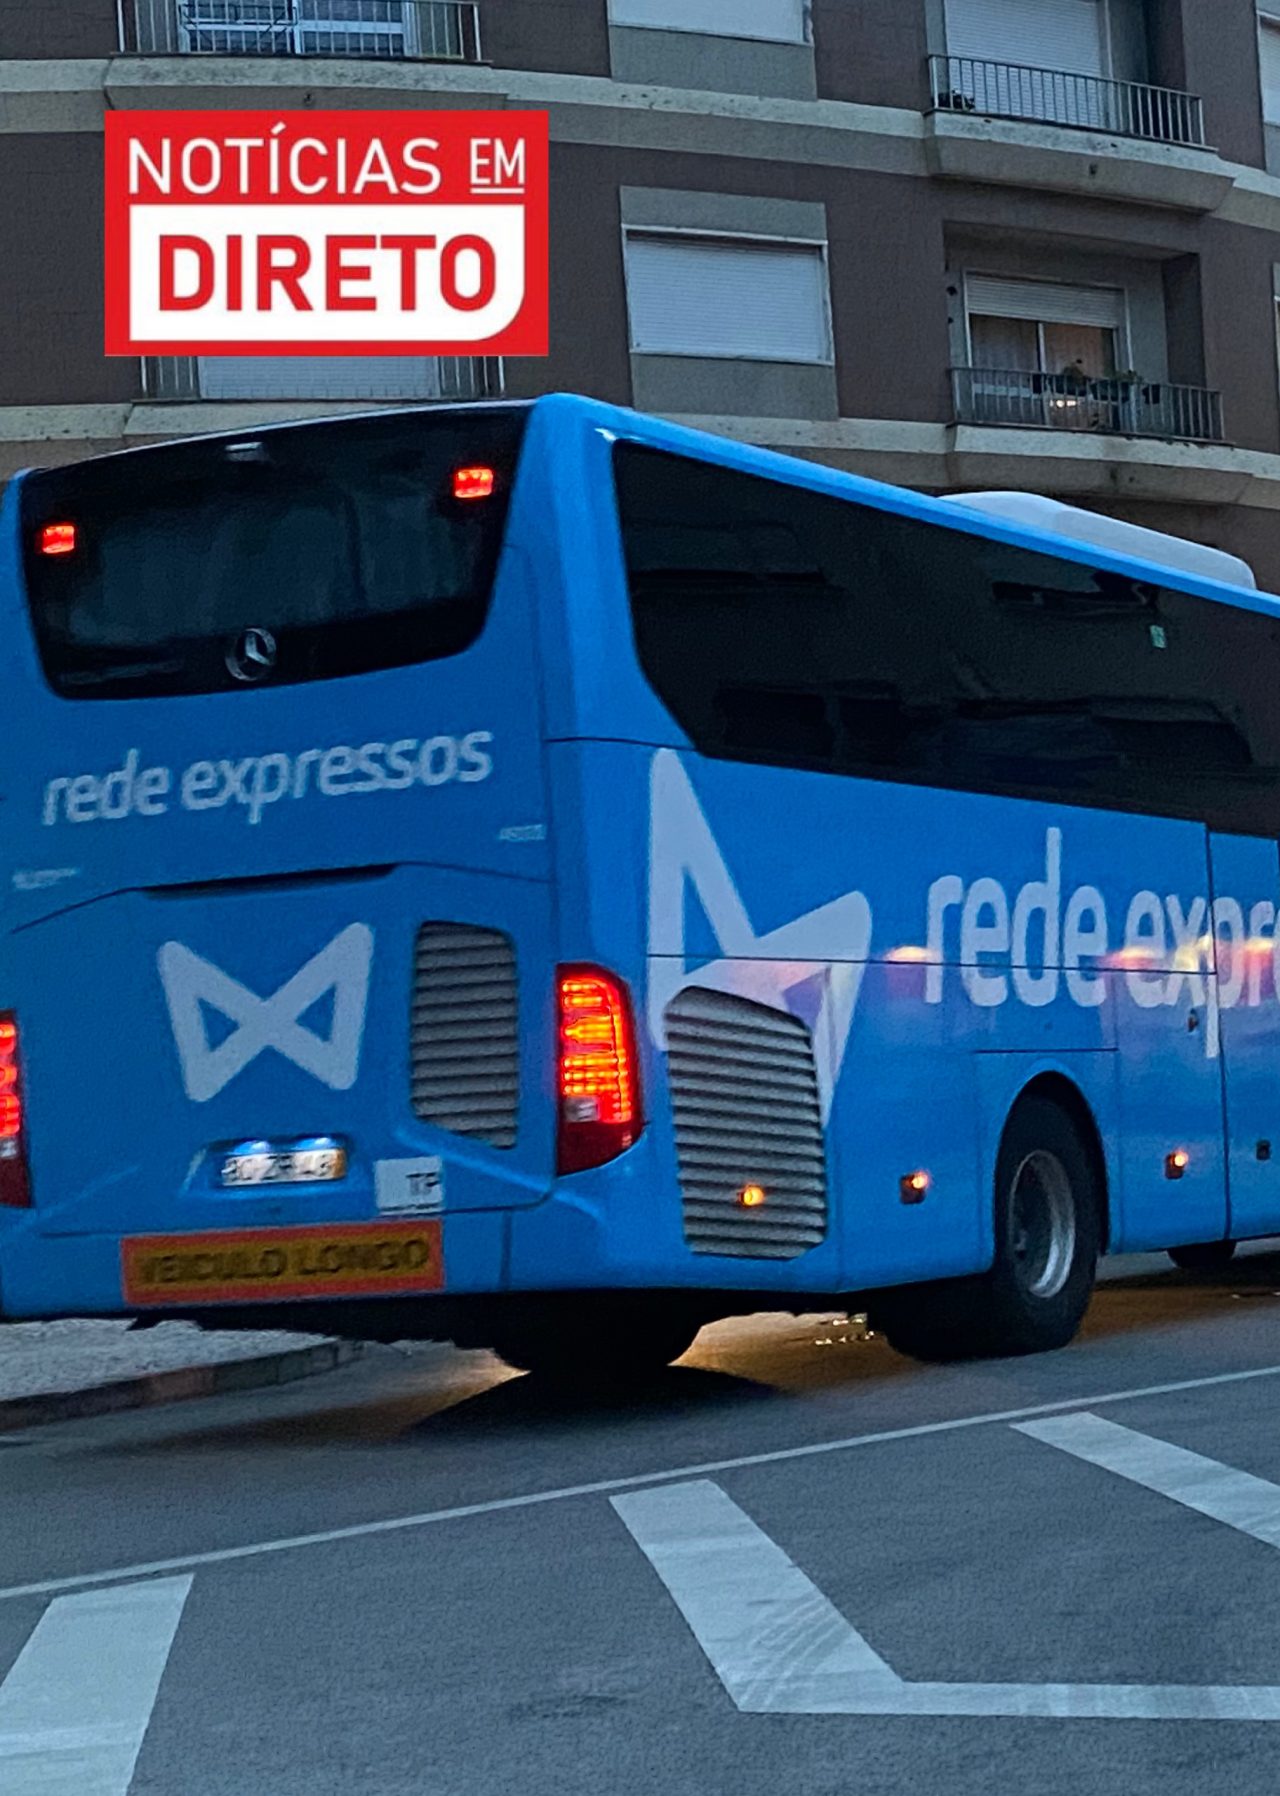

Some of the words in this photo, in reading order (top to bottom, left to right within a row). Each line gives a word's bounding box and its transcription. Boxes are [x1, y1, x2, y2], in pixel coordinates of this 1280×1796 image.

[41, 748, 169, 826] rede
[180, 731, 494, 825] expressos
[926, 826, 1108, 1007] rede
